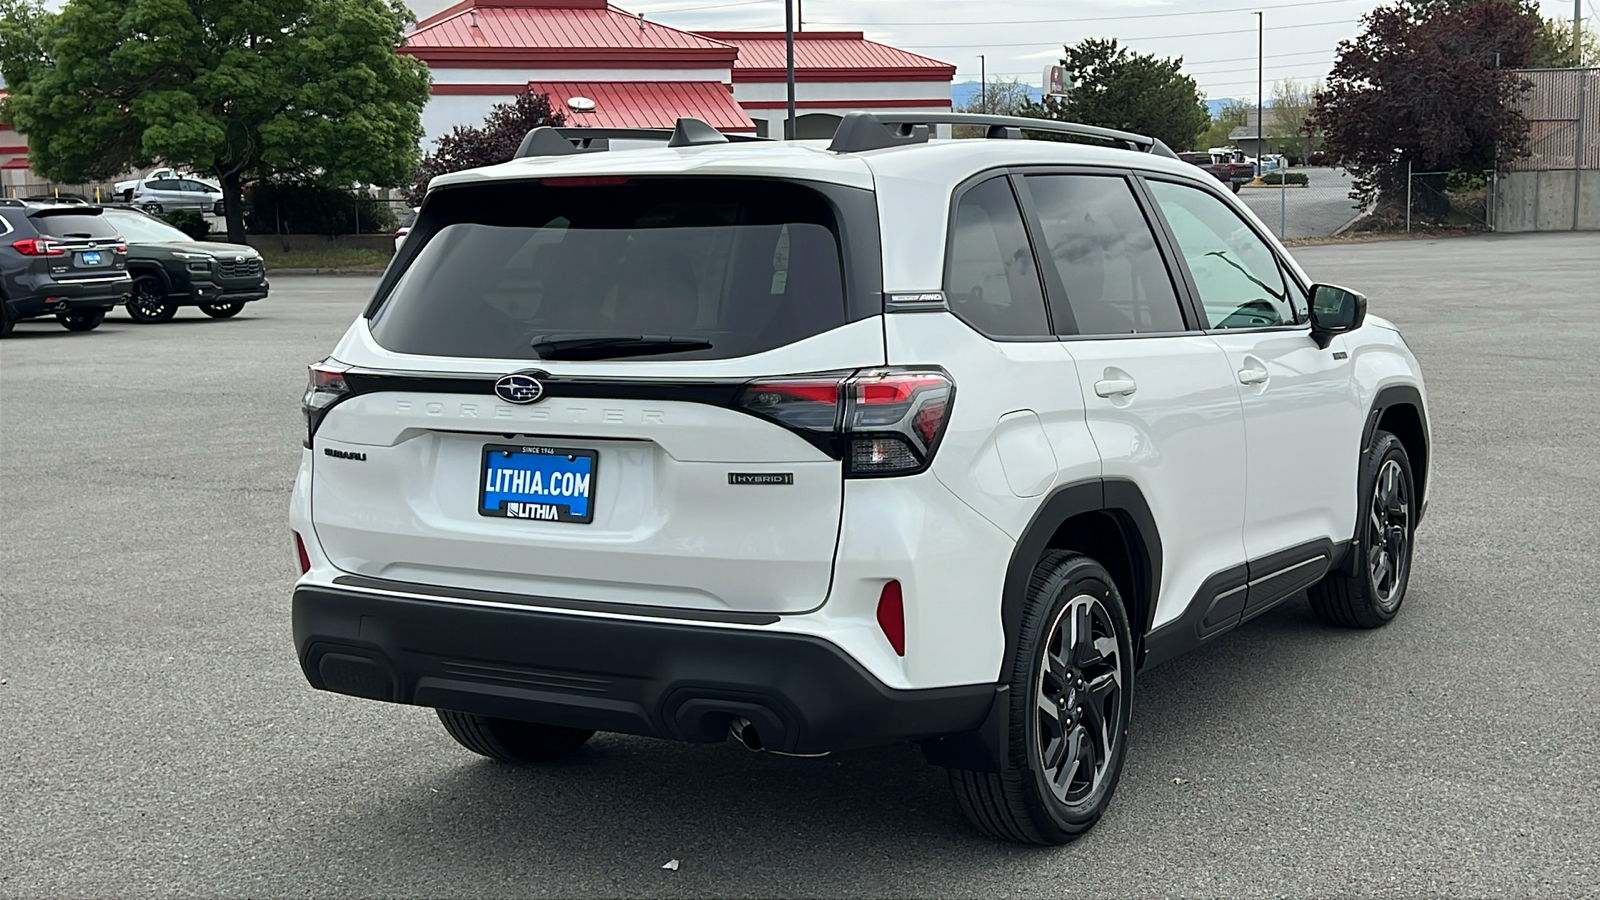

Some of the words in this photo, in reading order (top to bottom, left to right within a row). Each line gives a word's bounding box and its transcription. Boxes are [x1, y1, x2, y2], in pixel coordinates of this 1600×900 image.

[394, 400, 666, 425] FORESTER
[324, 448, 367, 461] SUBARU
[541, 447, 555, 455] 1946
[486, 468, 590, 498] LITHIA.COM
[518, 503, 559, 520] LITHIA
